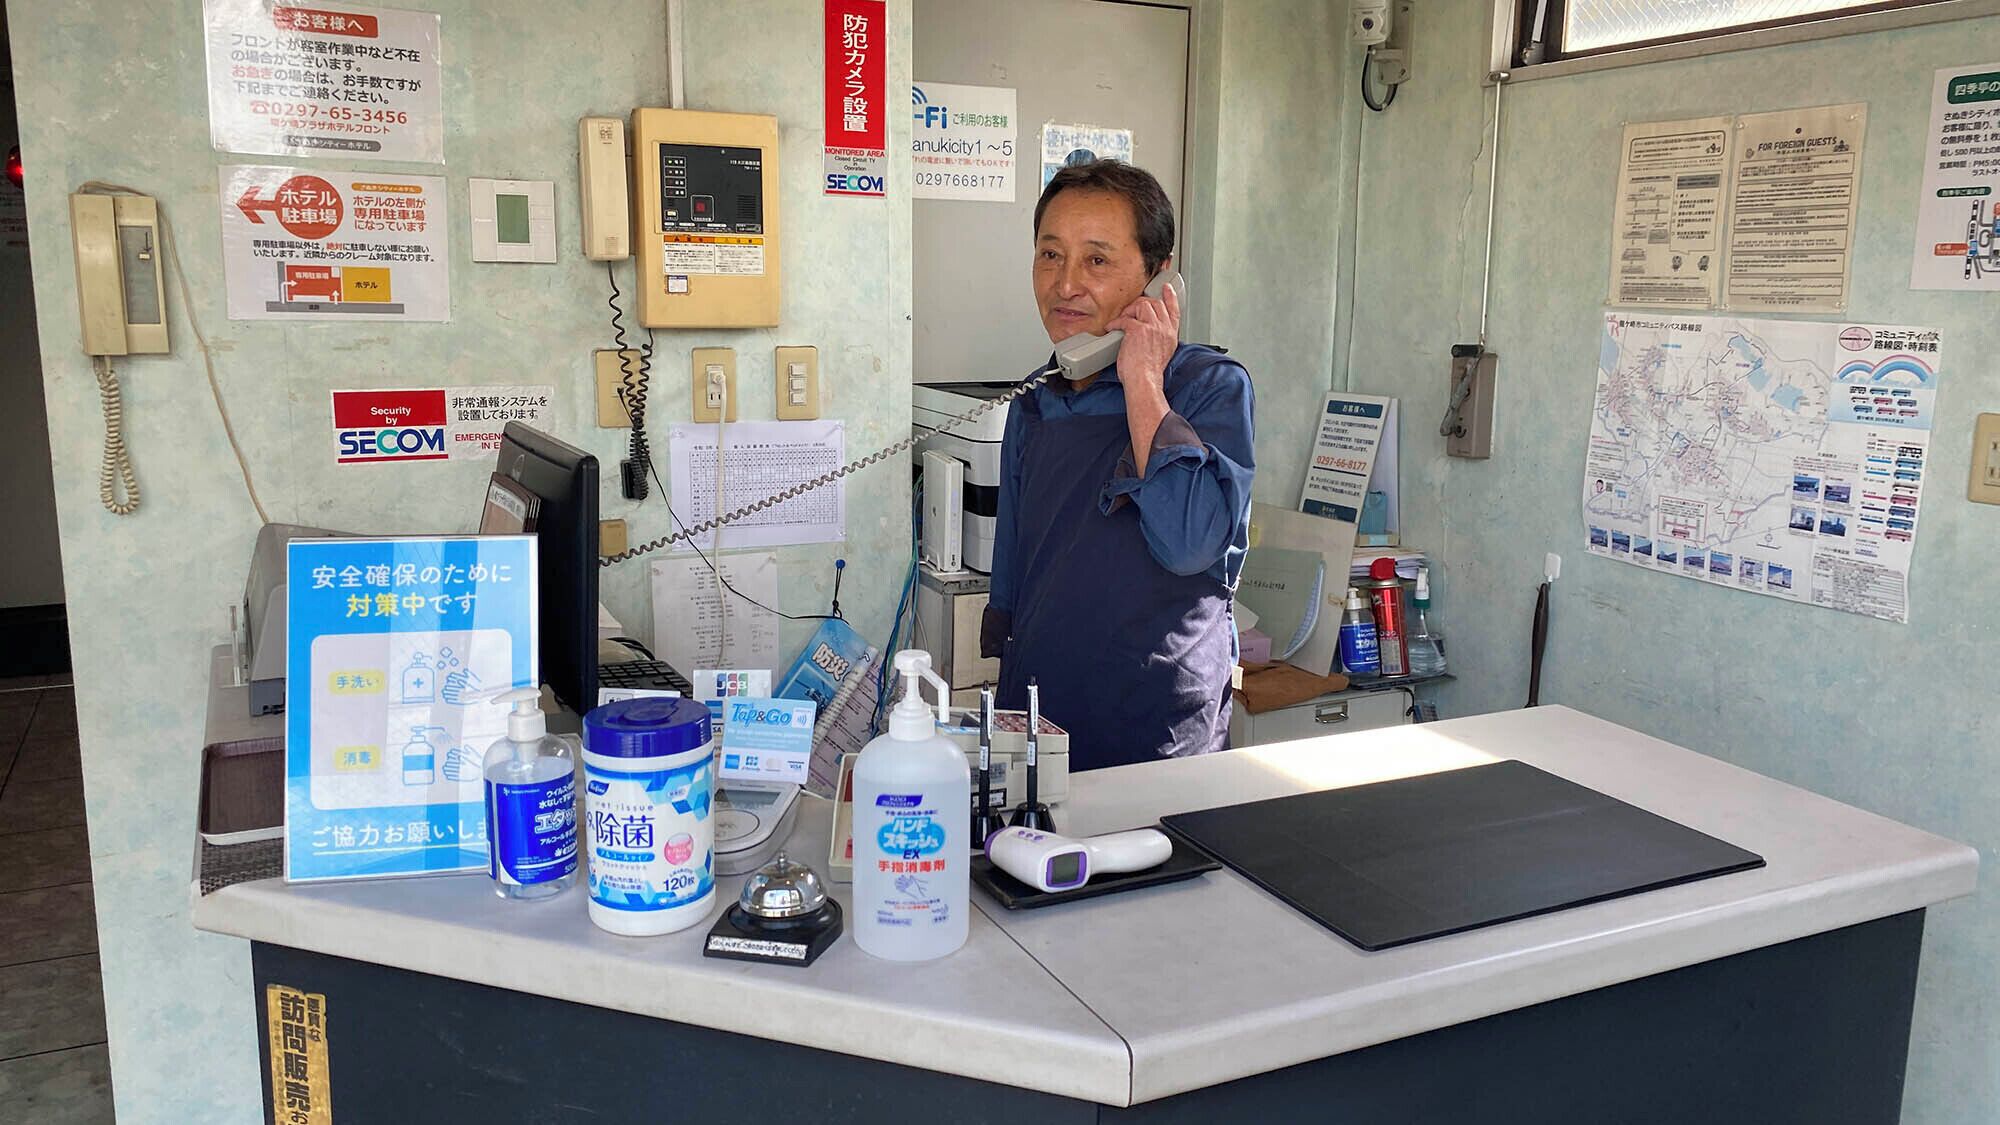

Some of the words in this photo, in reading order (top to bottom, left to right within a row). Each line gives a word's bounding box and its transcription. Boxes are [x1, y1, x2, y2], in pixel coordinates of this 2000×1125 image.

[293, 12, 365, 33] お客様へ
[231, 34, 421, 63] フロントが客室作業中など不在
[231, 51, 363, 73] の場合がございます。
[231, 65, 422, 92] お急ぎの場合は、お手数ですが
[842, 14, 869, 133] 防犯カメラ設置
[233, 80, 390, 105] 下記までご連絡ください。
[271, 102, 408, 125] 0297-65-3456
[914, 106, 948, 130] -Fi
[952, 112, 1009, 129] ご利用のお客様
[825, 147, 865, 156] MONITORED
[1758, 142, 1772, 152] FOR
[1806, 136, 1838, 147] GUESTS
[827, 174, 883, 191] SECOM
[915, 172, 1005, 189] 0297668177
[281, 189, 337, 206] ホテル
[352, 196, 426, 209] ホテルの左側が
[282, 207, 338, 225] 駐車場
[354, 207, 426, 221] 専用駐車場
[354, 220, 427, 233] になっています
[355, 281, 378, 290] ホテル
[452, 396, 548, 409] 非常通報システムを
[370, 406, 412, 418] Security
[457, 409, 539, 421] 設置しております。
[385, 416, 398, 426] by
[339, 428, 445, 456] SECOM
[481, 441, 491, 450] IN
[312, 563, 512, 590] 安全確保のために
[345, 592, 477, 618] 対策中です
[336, 674, 380, 689] 手洗い
[732, 703, 793, 728] Tap&Go
[893, 818, 930, 833] ハンド
[312, 820, 489, 849] ご協力お願いしま
[883, 833, 939, 849] スキッシュ
[903, 850, 920, 860] EX
[878, 858, 946, 873] 手指消毒剤
